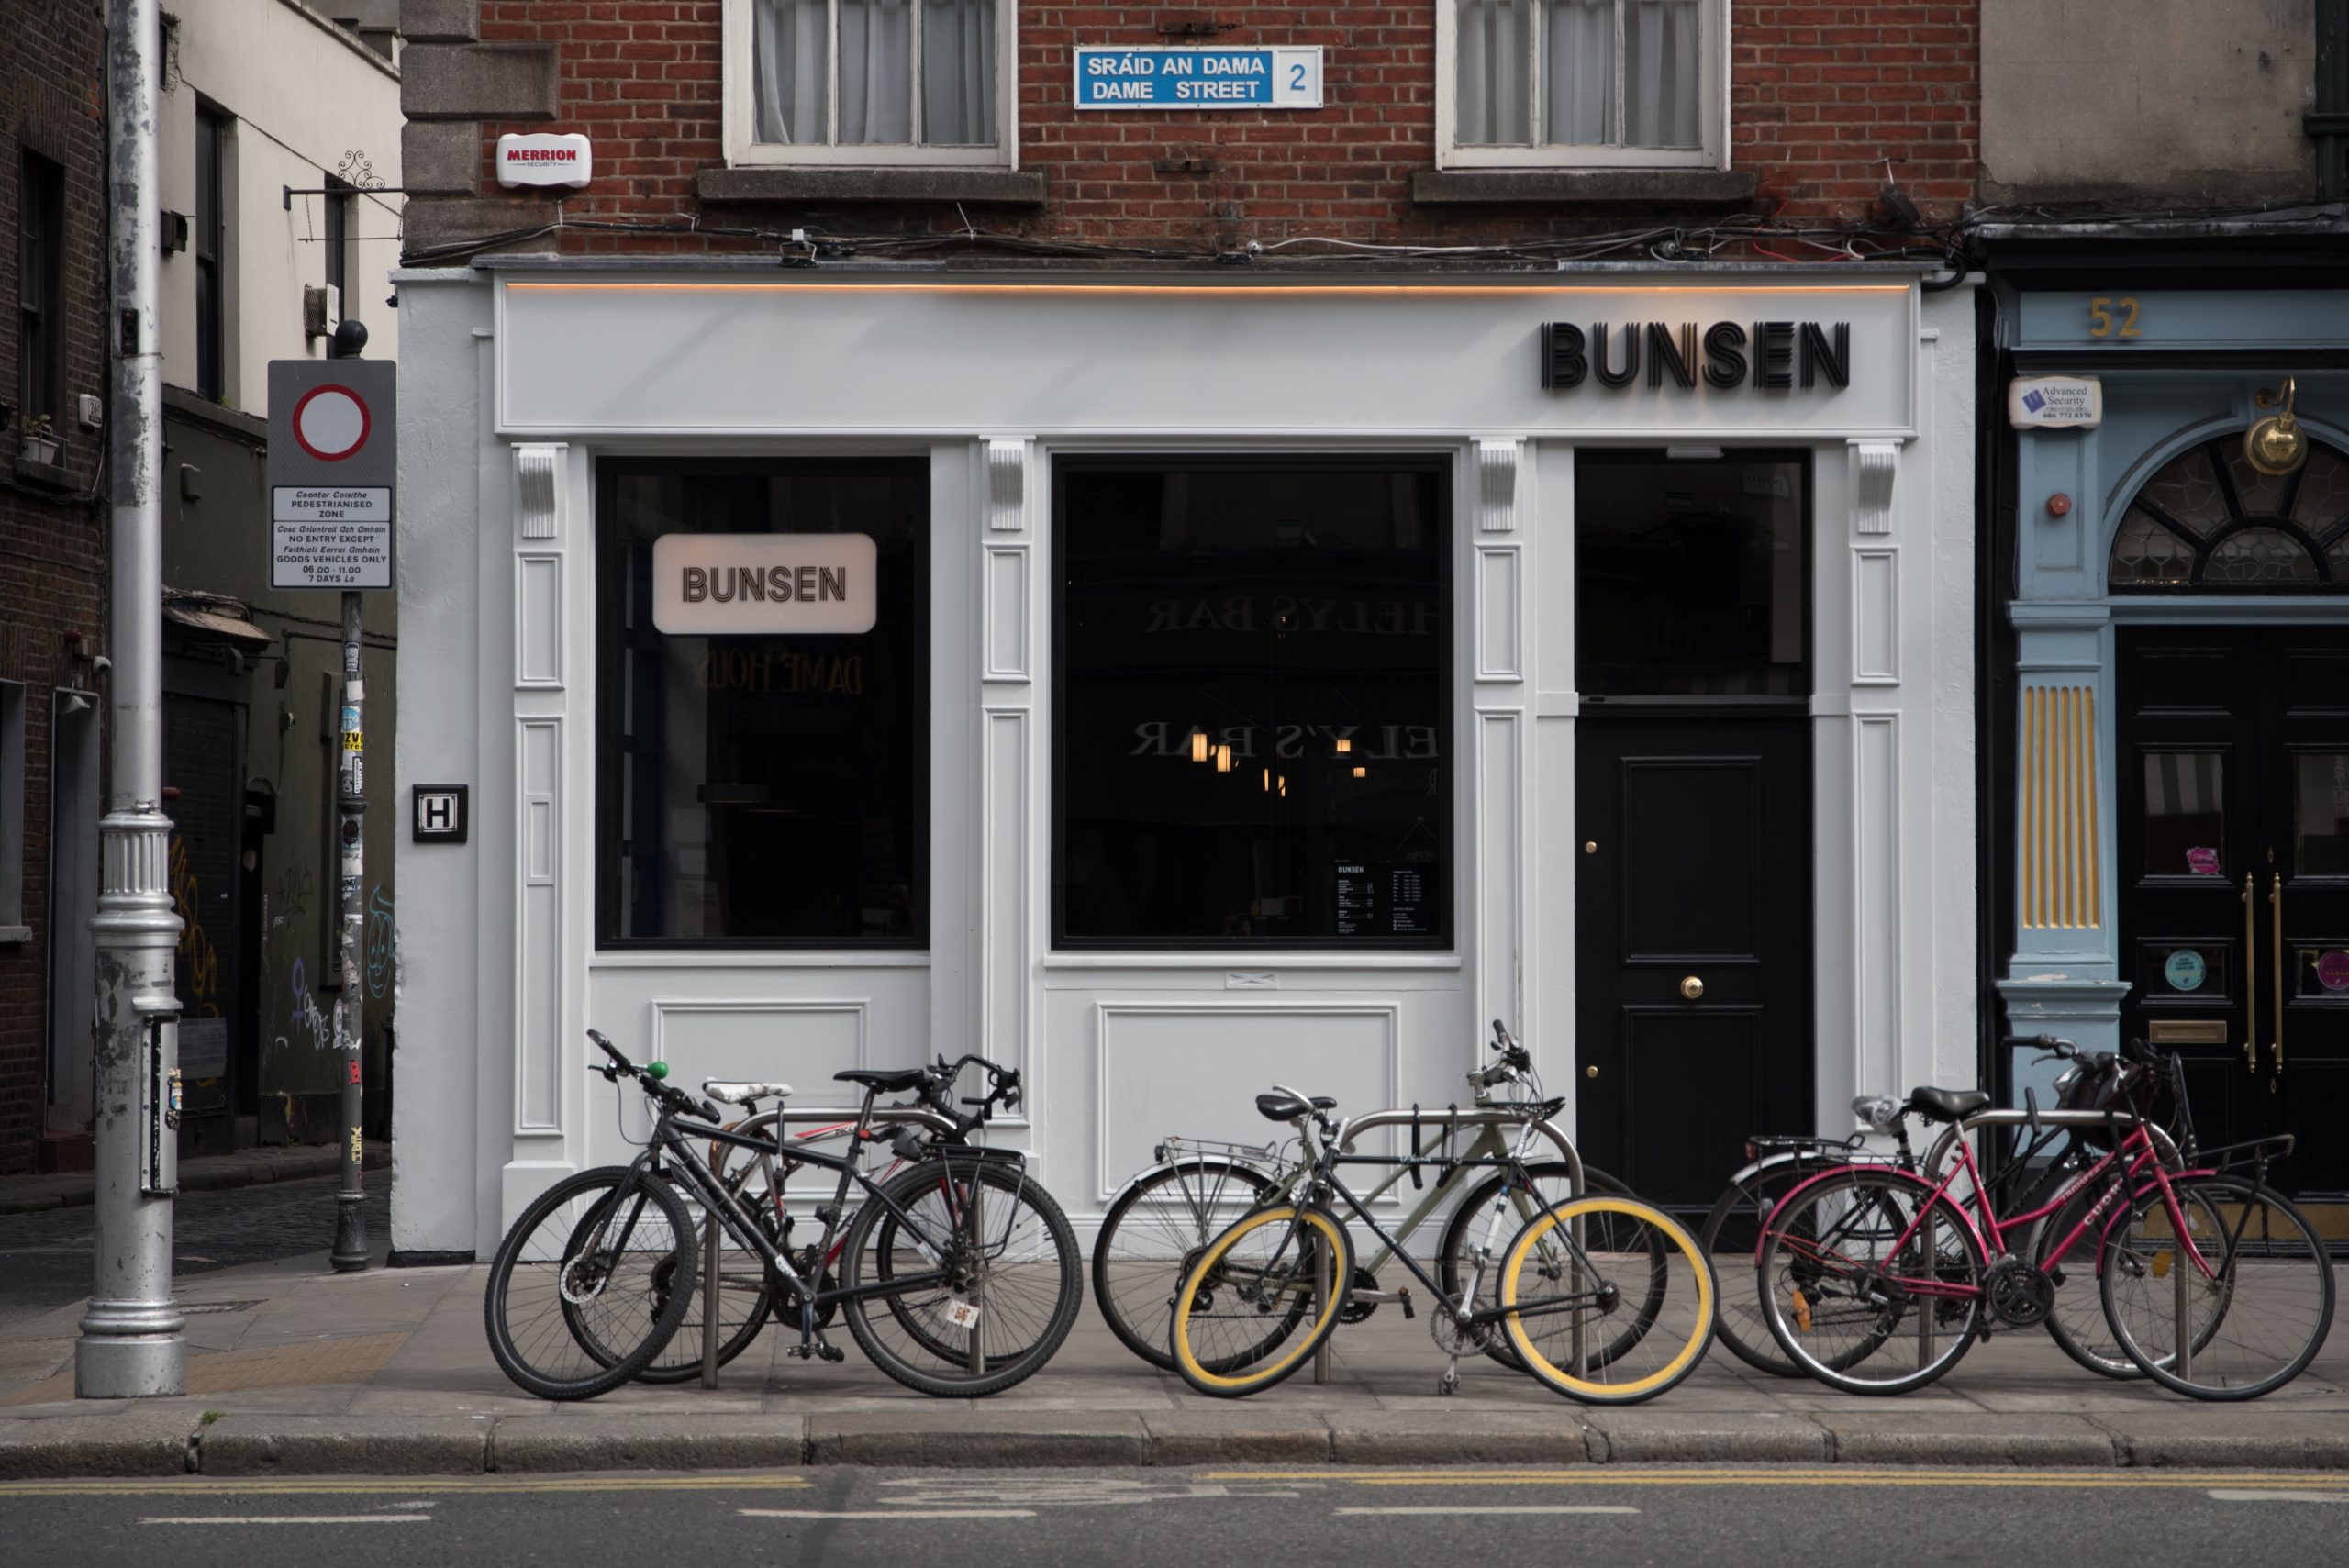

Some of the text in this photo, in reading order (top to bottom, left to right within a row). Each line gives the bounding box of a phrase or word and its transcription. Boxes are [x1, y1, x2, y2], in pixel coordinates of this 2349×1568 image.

[1088, 53, 1265, 75] SRÁID AN DAMA
[1290, 64, 1306, 91] 2
[1093, 81, 1260, 99] DAME STREET
[507, 150, 576, 161] MERRION
[2089, 297, 2142, 337] 52
[1541, 321, 1850, 390] BUNSEN
[2043, 386, 2087, 395] Advanced
[2048, 396, 2085, 407] Security
[683, 566, 846, 603] BUNSEN
[427, 798, 449, 828] H
[2084, 1176, 2123, 1225] CUOR
